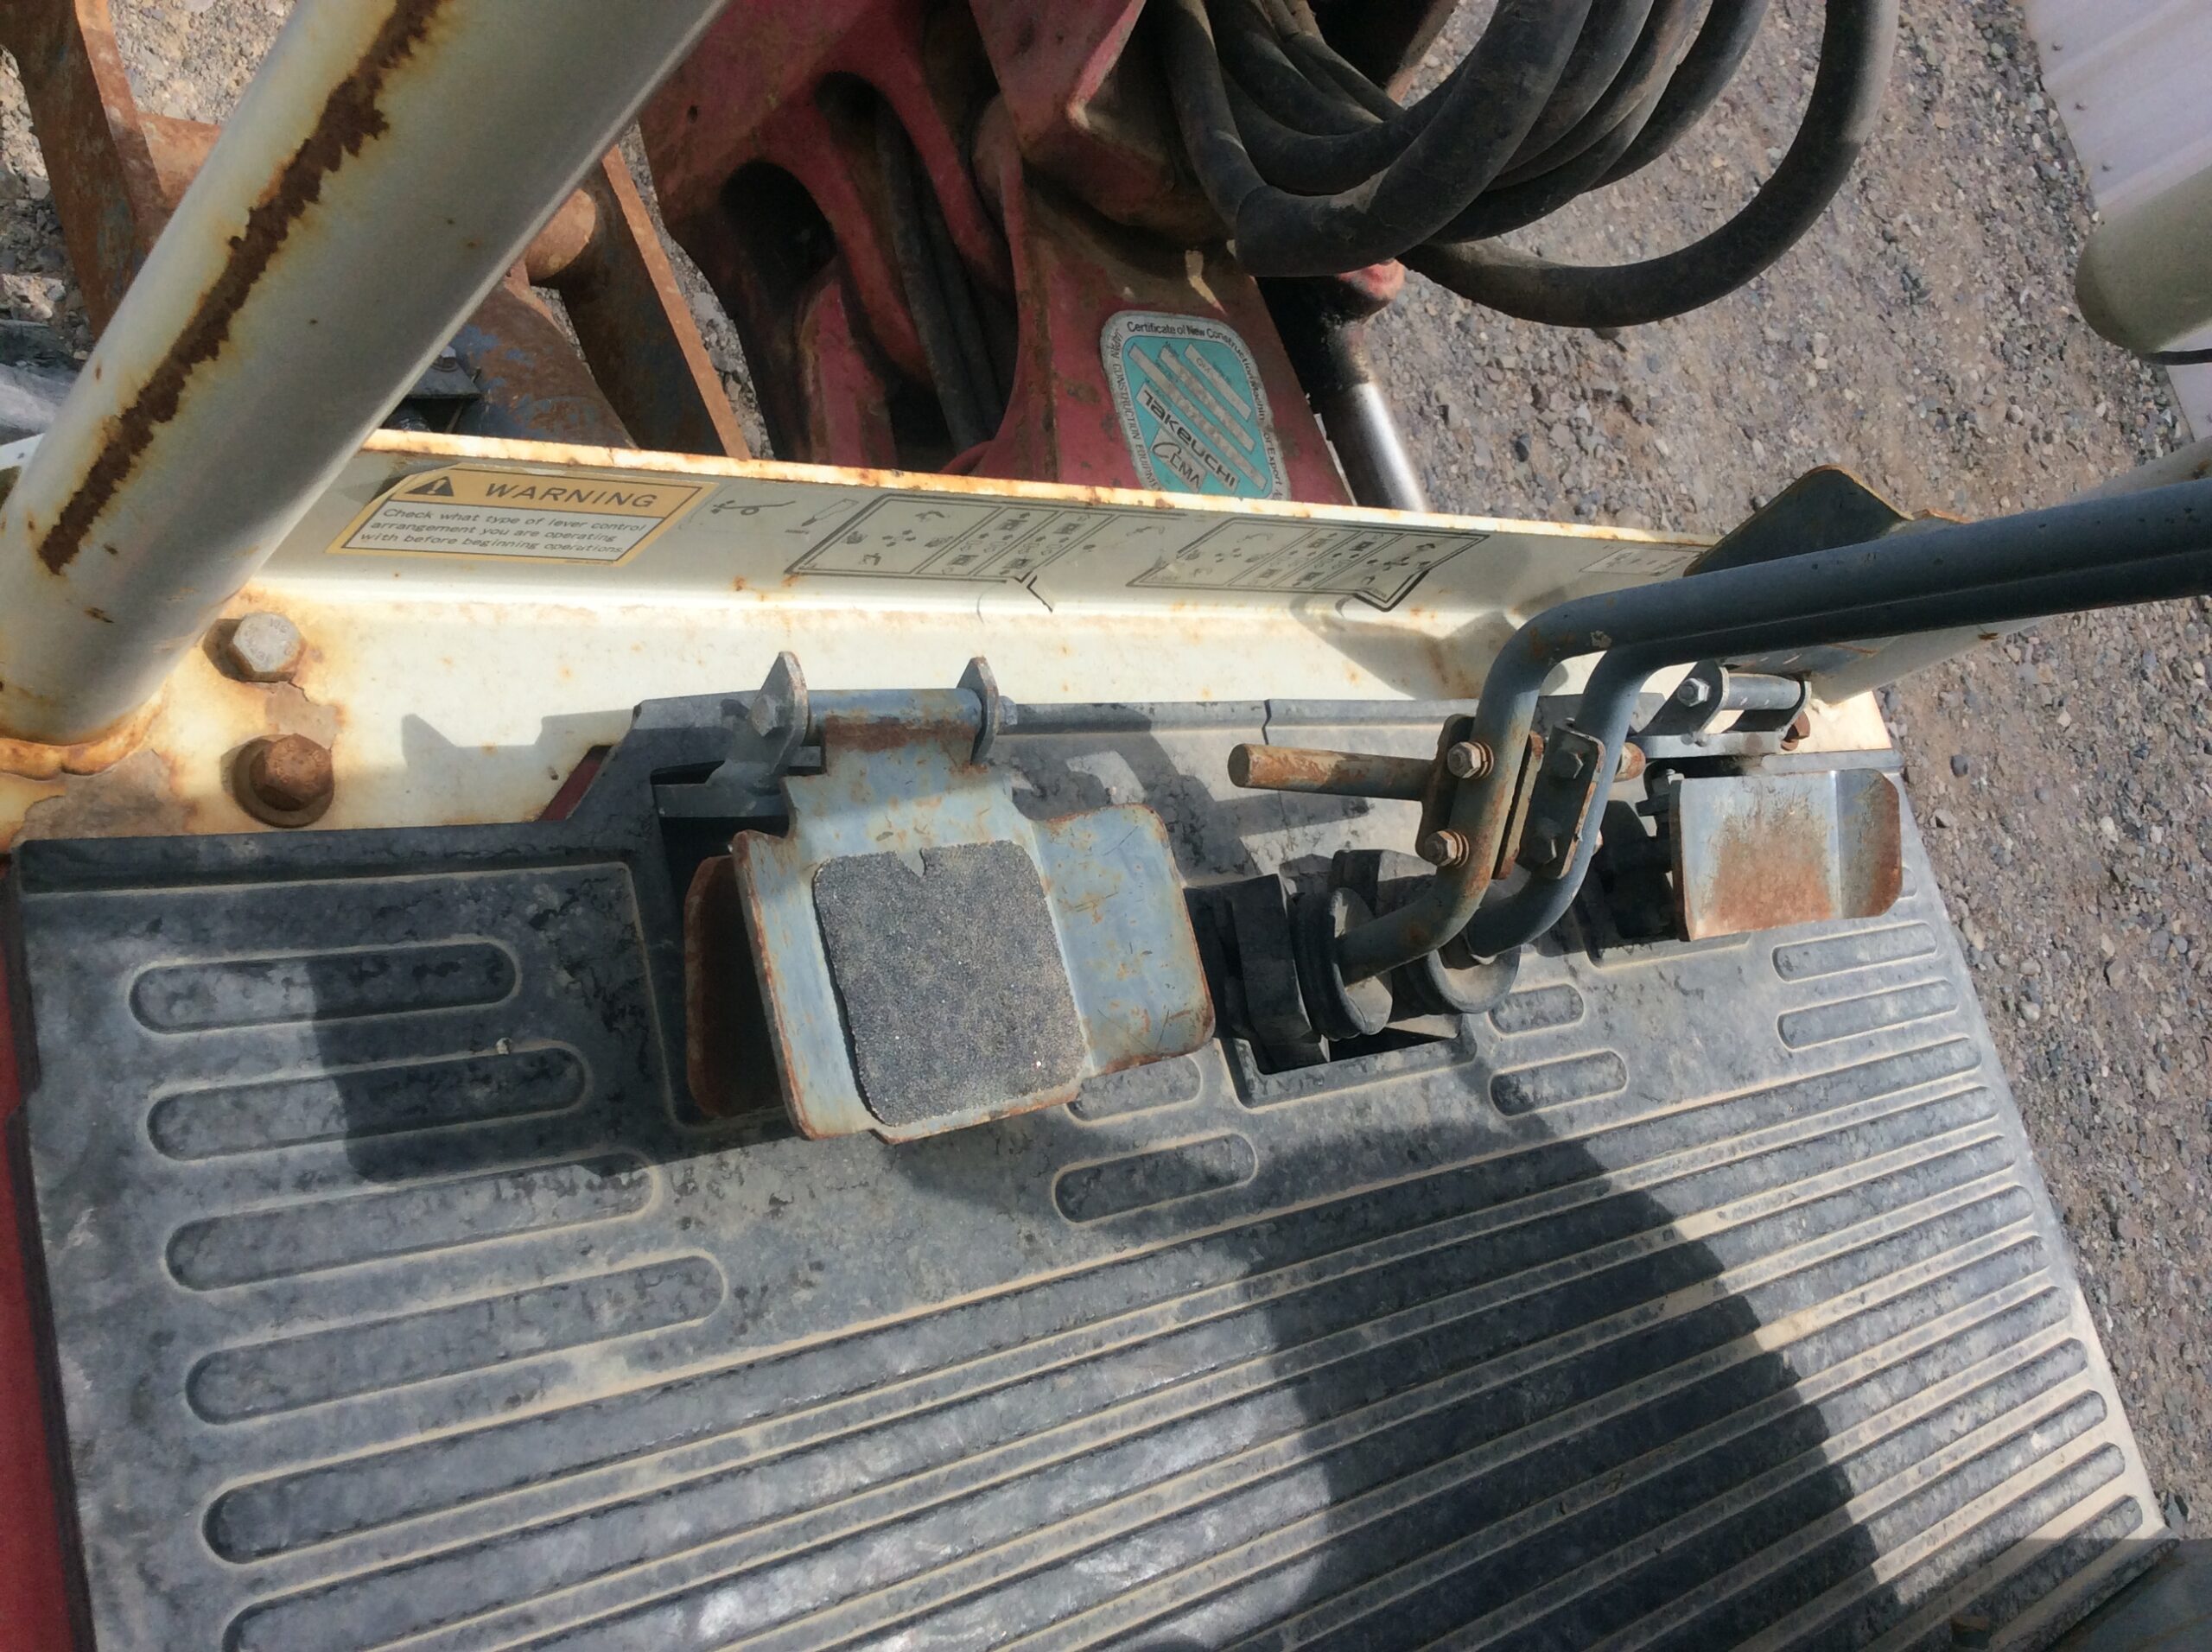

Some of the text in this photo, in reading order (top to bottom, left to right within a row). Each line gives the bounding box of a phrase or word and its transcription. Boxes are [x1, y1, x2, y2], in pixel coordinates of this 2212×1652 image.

[1113, 363, 1141, 440] CONSTRUCTION
[1127, 321, 1176, 335] Certificate
[1177, 324, 1186, 335] of
[1186, 325, 1205, 336] New
[1206, 328, 1254, 378] Construction
[1251, 378, 1267, 423] Machin
[1267, 447, 1283, 486] Export
[485, 482, 658, 508] WARNING
[370, 521, 618, 543] arrangement you are operating
[383, 508, 647, 532] Check what type of lever control
[360, 532, 624, 554] with before beginning operations.
